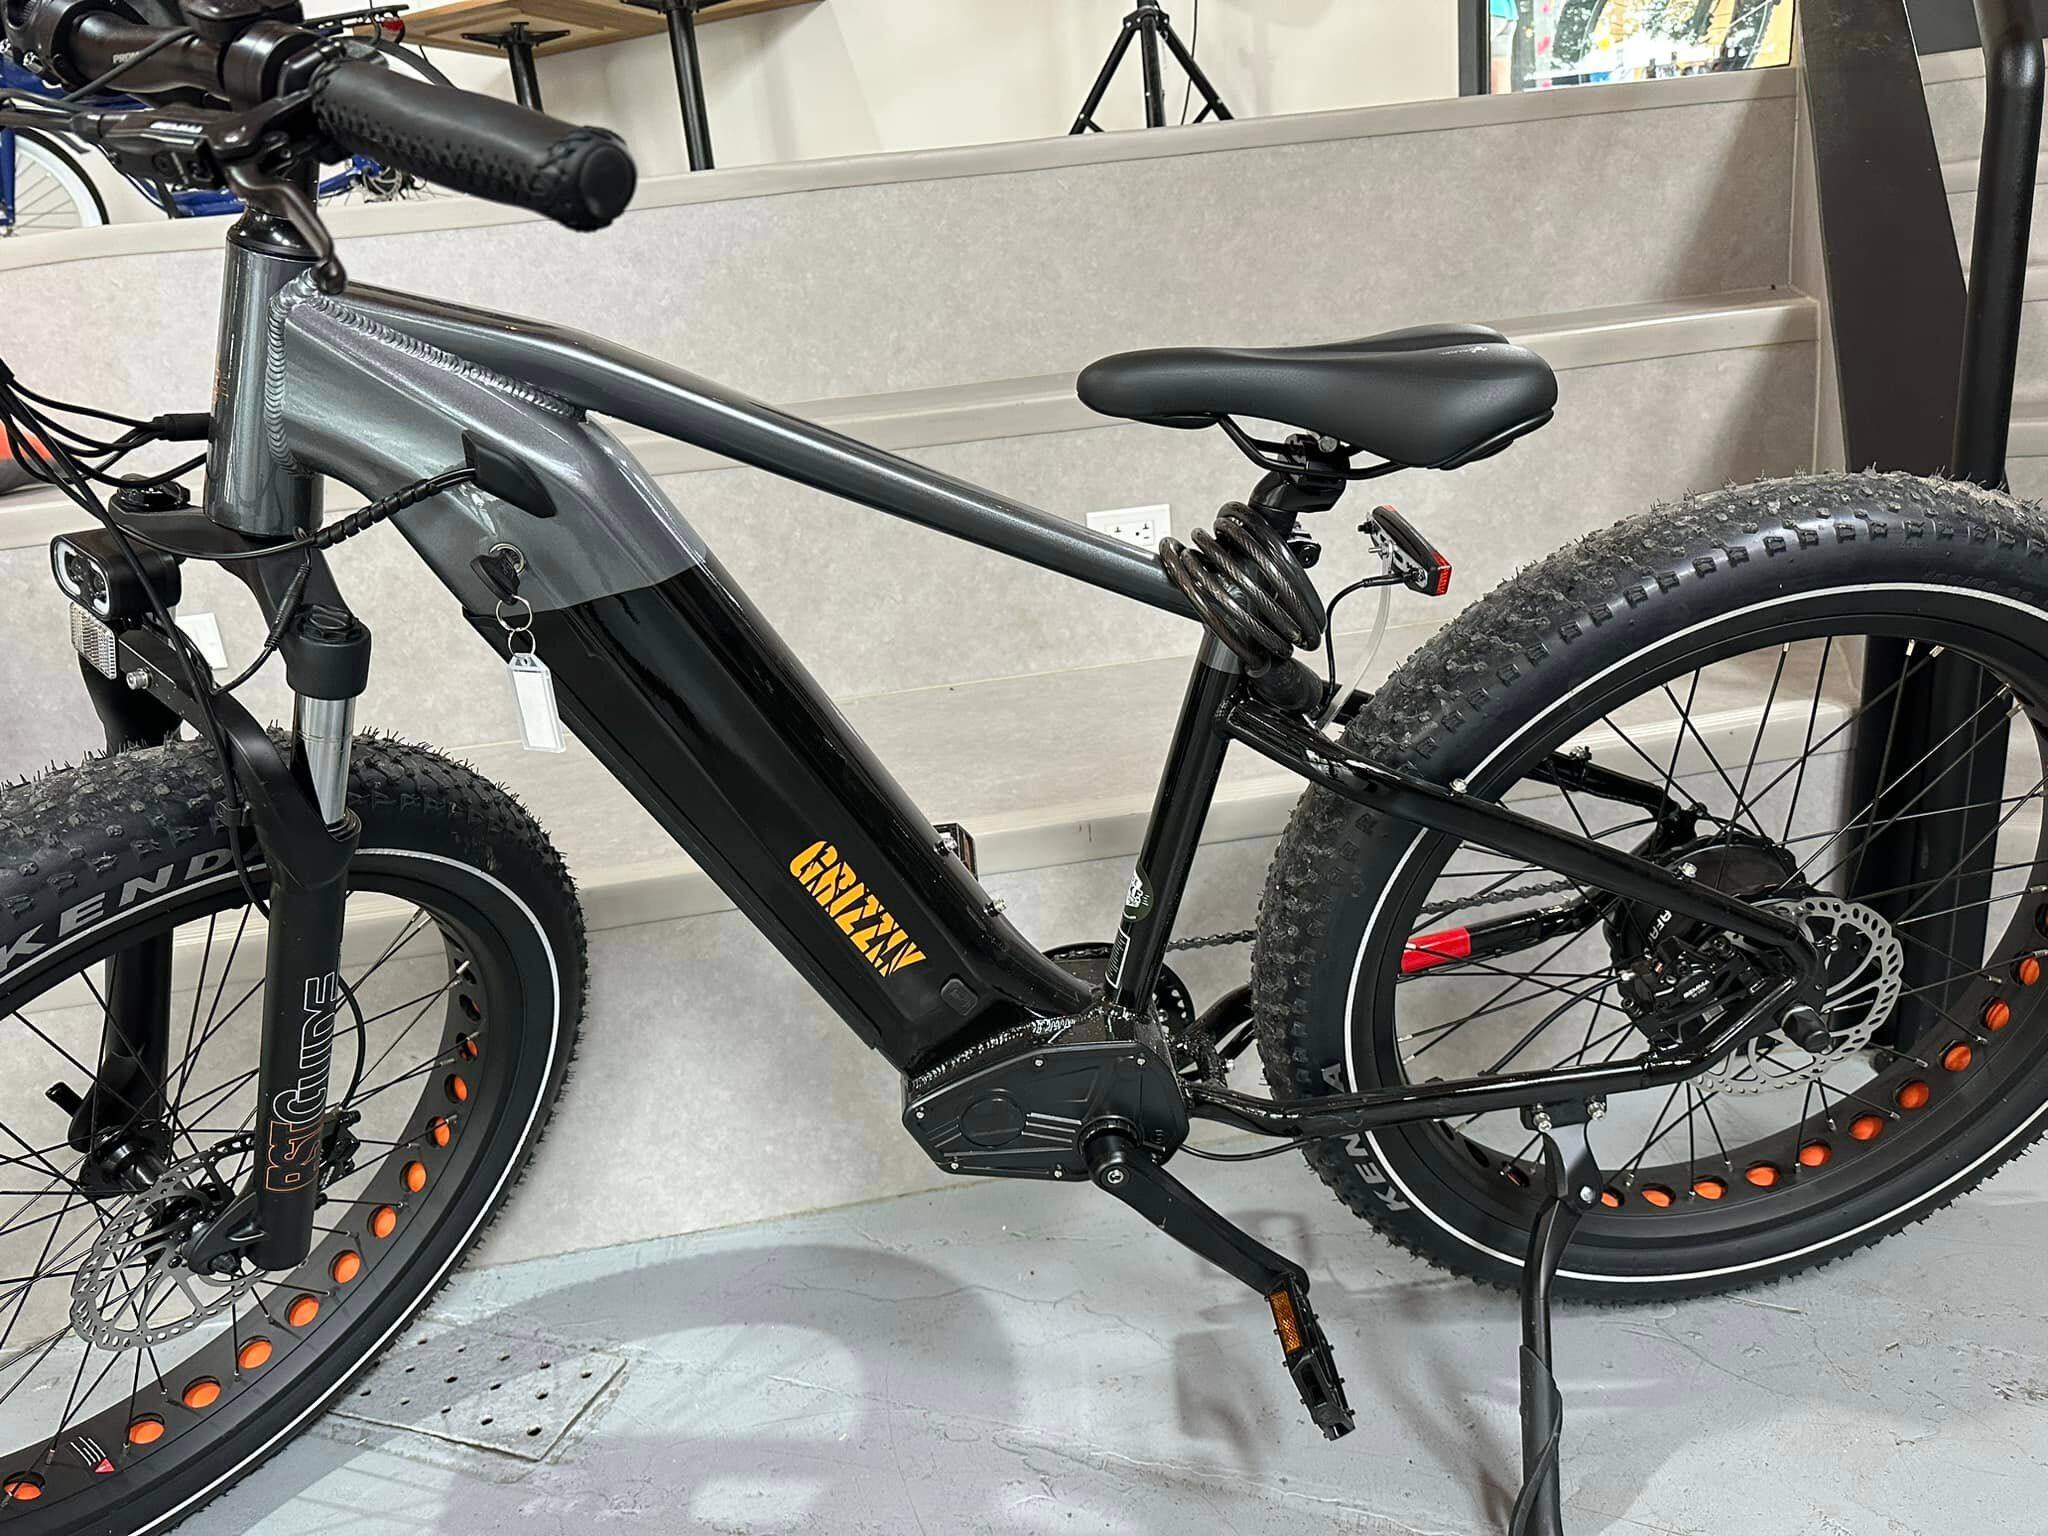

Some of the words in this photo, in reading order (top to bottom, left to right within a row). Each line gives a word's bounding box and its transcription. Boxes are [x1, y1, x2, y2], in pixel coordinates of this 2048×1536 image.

[0, 848, 240, 972] KEND
[789, 840, 927, 977] GRIZZLY
[1321, 1063, 1410, 1211] KENA
